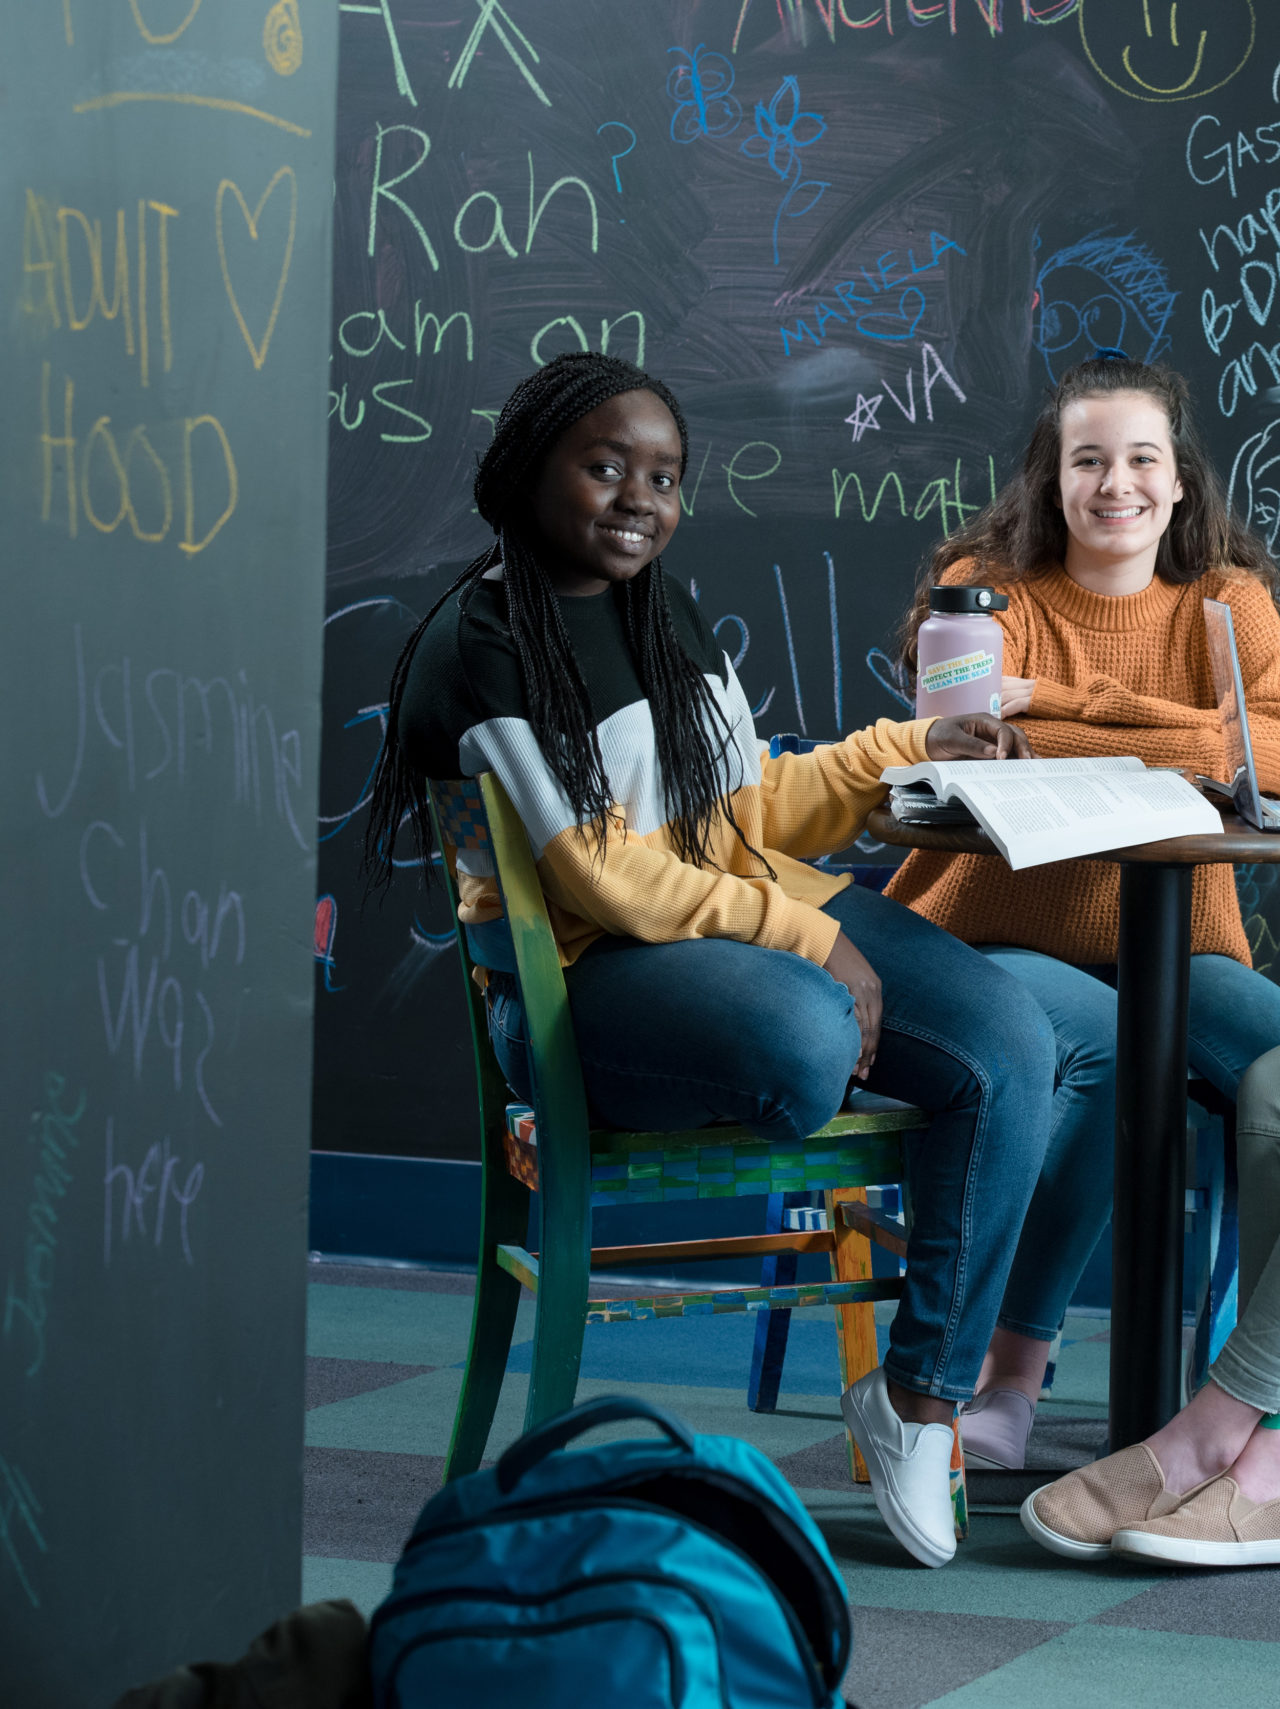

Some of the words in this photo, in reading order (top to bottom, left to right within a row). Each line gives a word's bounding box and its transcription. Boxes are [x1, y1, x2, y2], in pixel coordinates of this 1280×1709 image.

[780, 231, 967, 356] MARIELA
[338, 299, 474, 361] am
[922, 670, 953, 685] PROTECT
[954, 665, 970, 675] THE
[971, 657, 993, 670] TREES
[928, 678, 952, 691] CLEAN
[954, 674, 970, 683] THE
